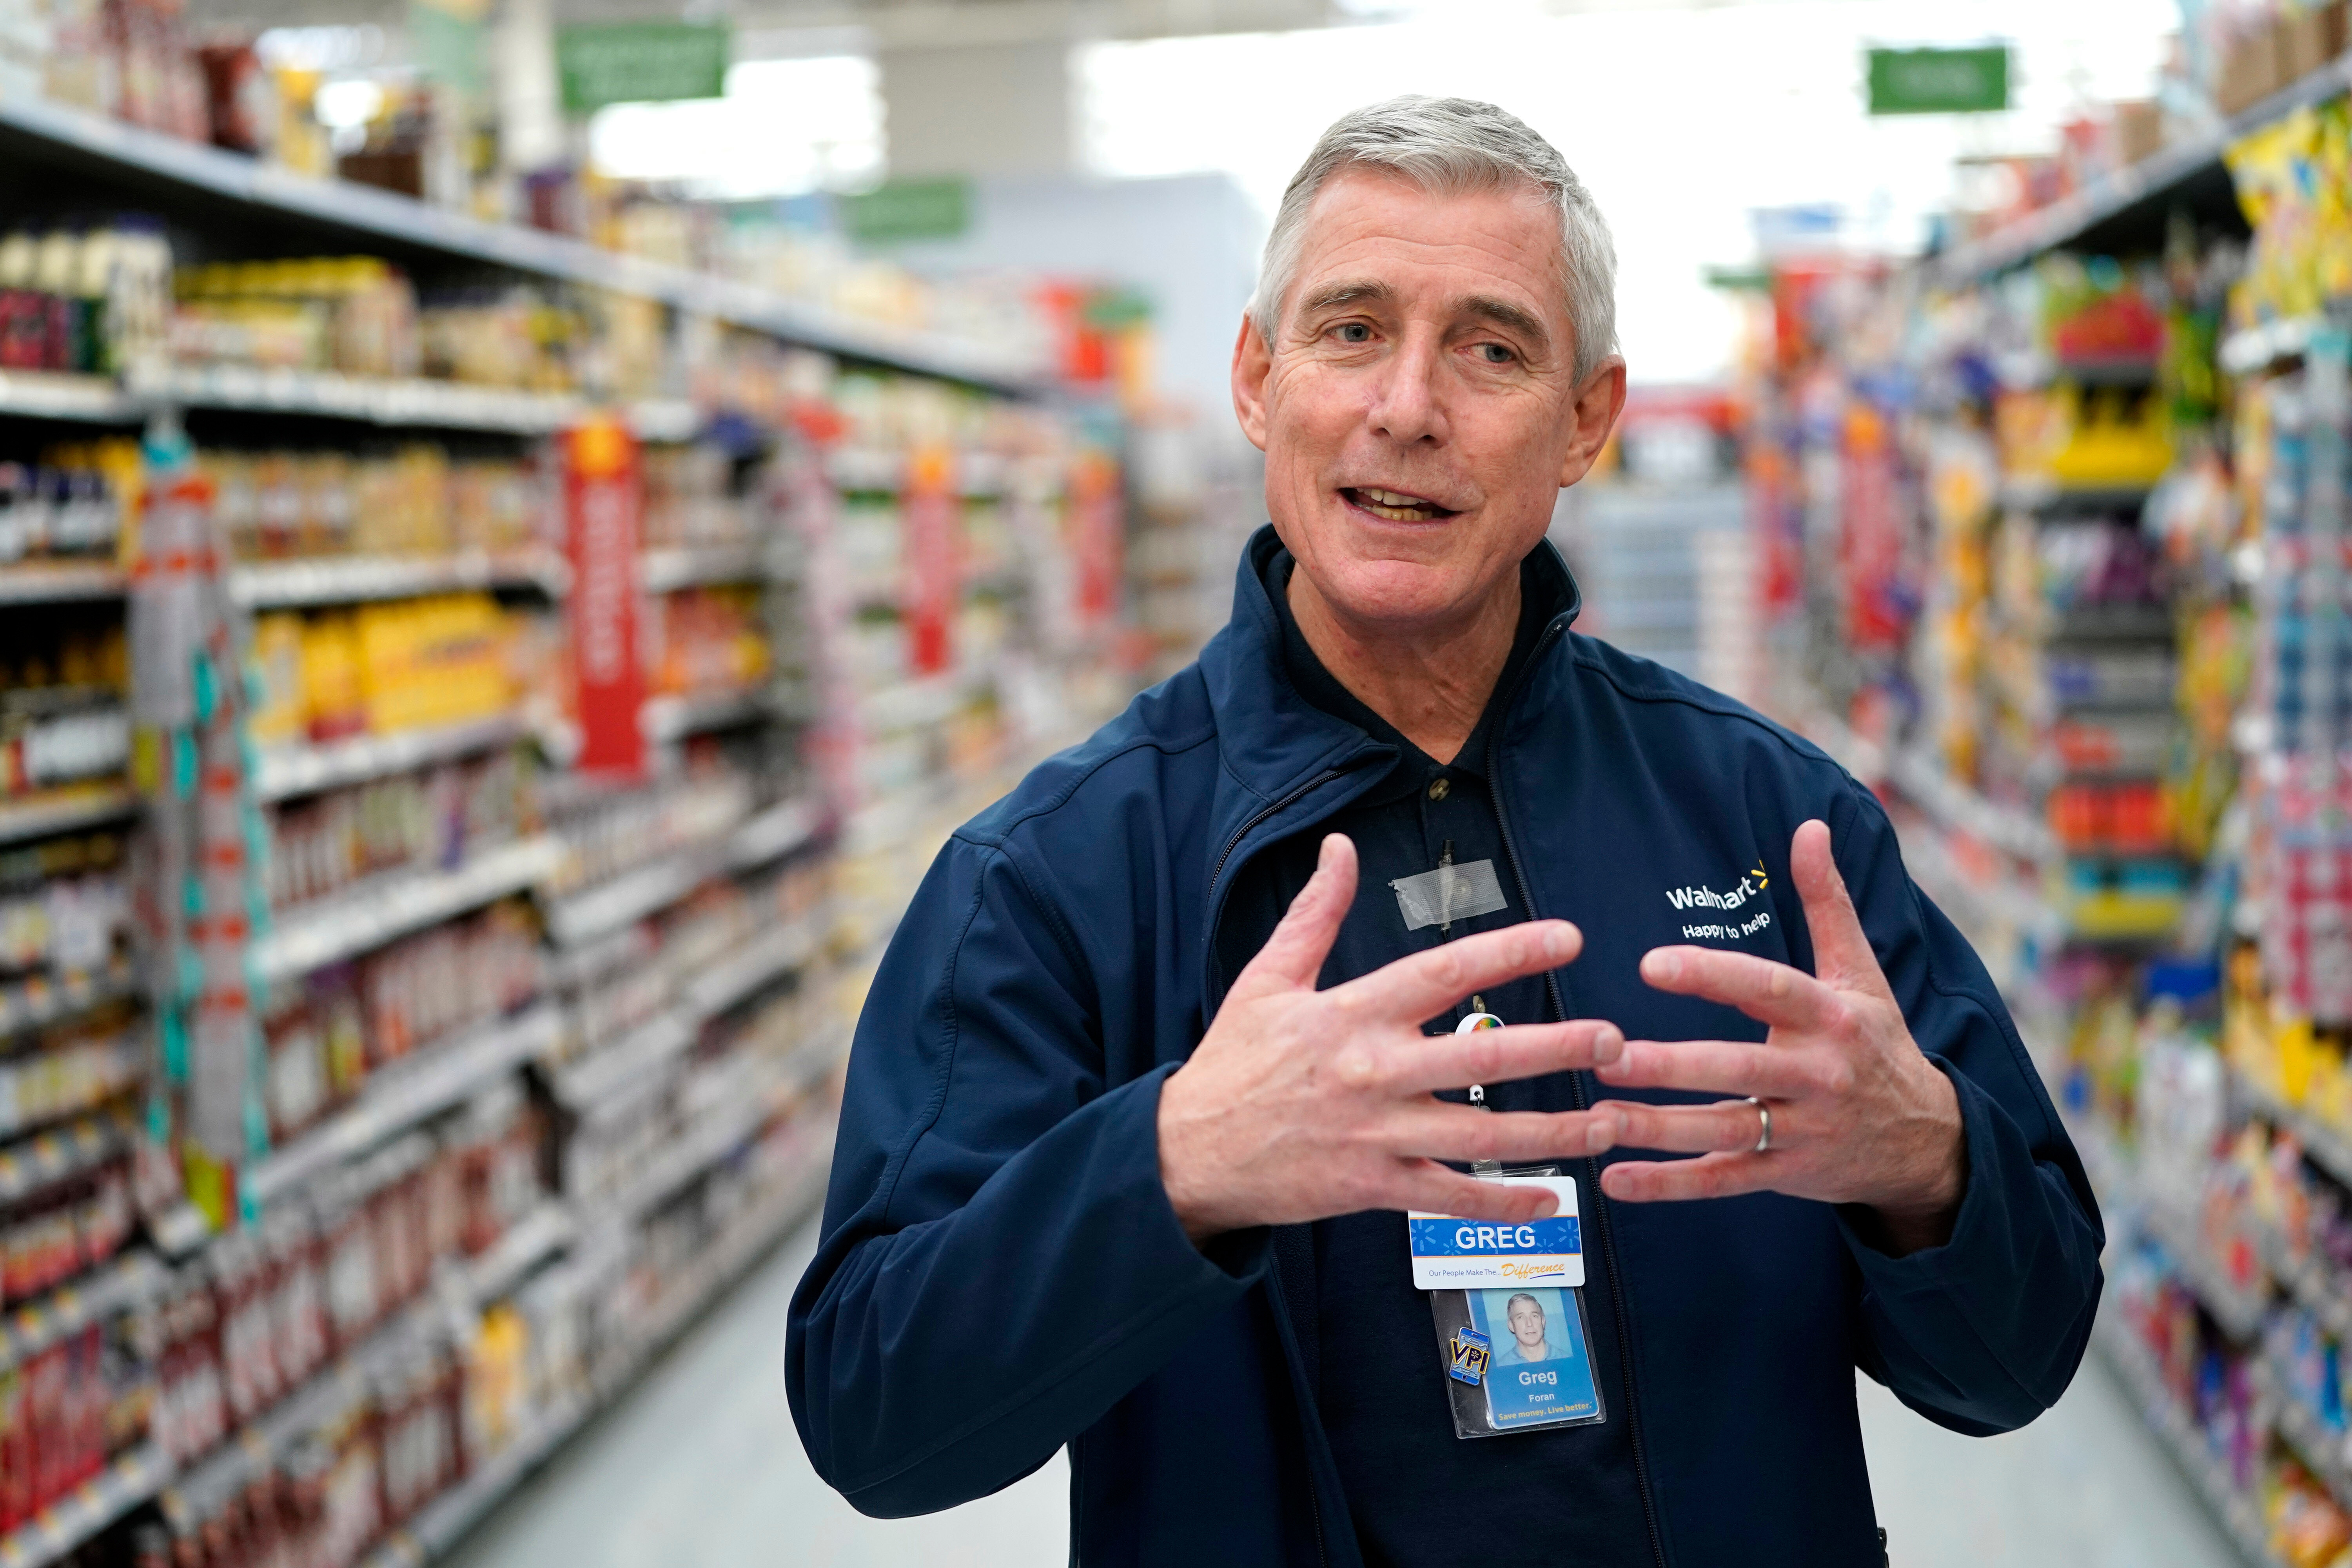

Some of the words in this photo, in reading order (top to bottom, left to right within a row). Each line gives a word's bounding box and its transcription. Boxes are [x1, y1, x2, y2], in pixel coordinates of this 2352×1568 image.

[1666, 877, 1757, 909] Walmart
[1682, 925, 1724, 939] Happy
[1726, 925, 1739, 938] to
[1741, 913, 1770, 935] help
[1455, 1226, 1535, 1249] GREG
[1501, 1263, 1565, 1279] Difference
[1450, 1338, 1490, 1375] VPI
[1519, 1371, 1557, 1385] Greg
[1529, 1393, 1555, 1403] Foran
[1518, 1408, 1546, 1417] money.
